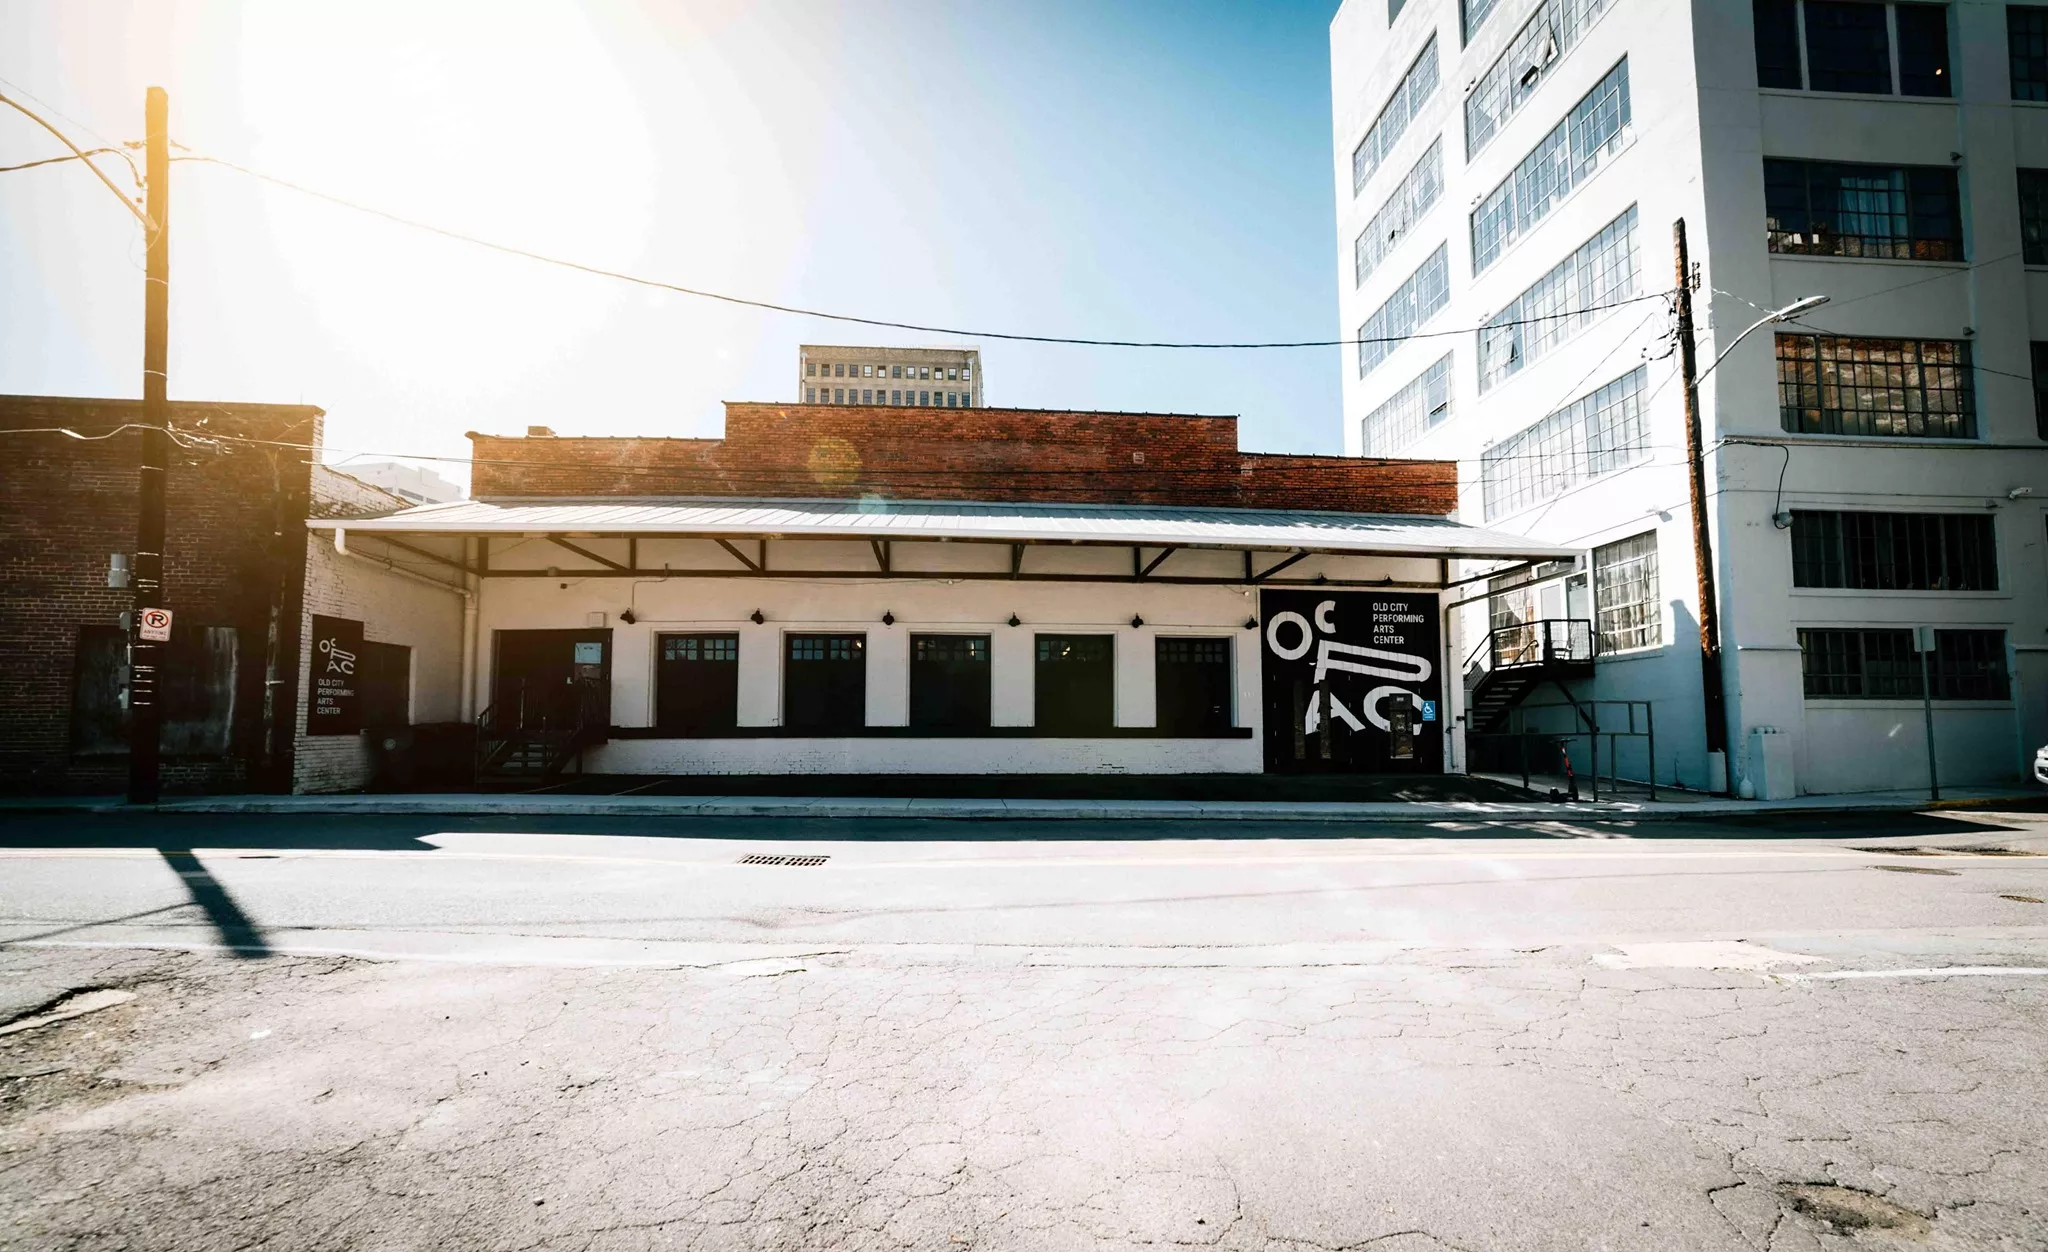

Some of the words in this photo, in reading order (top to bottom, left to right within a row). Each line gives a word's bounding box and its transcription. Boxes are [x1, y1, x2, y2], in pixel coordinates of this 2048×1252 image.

[1372, 602, 1388, 611] OLD
[1390, 602, 1408, 612] CITY
[1372, 613, 1424, 623] PERFORMING
[1373, 624, 1395, 634] ARTS
[1373, 635, 1405, 644] CENTER
[317, 688, 354, 696] PERFORMING
[316, 707, 341, 715] CENTER
